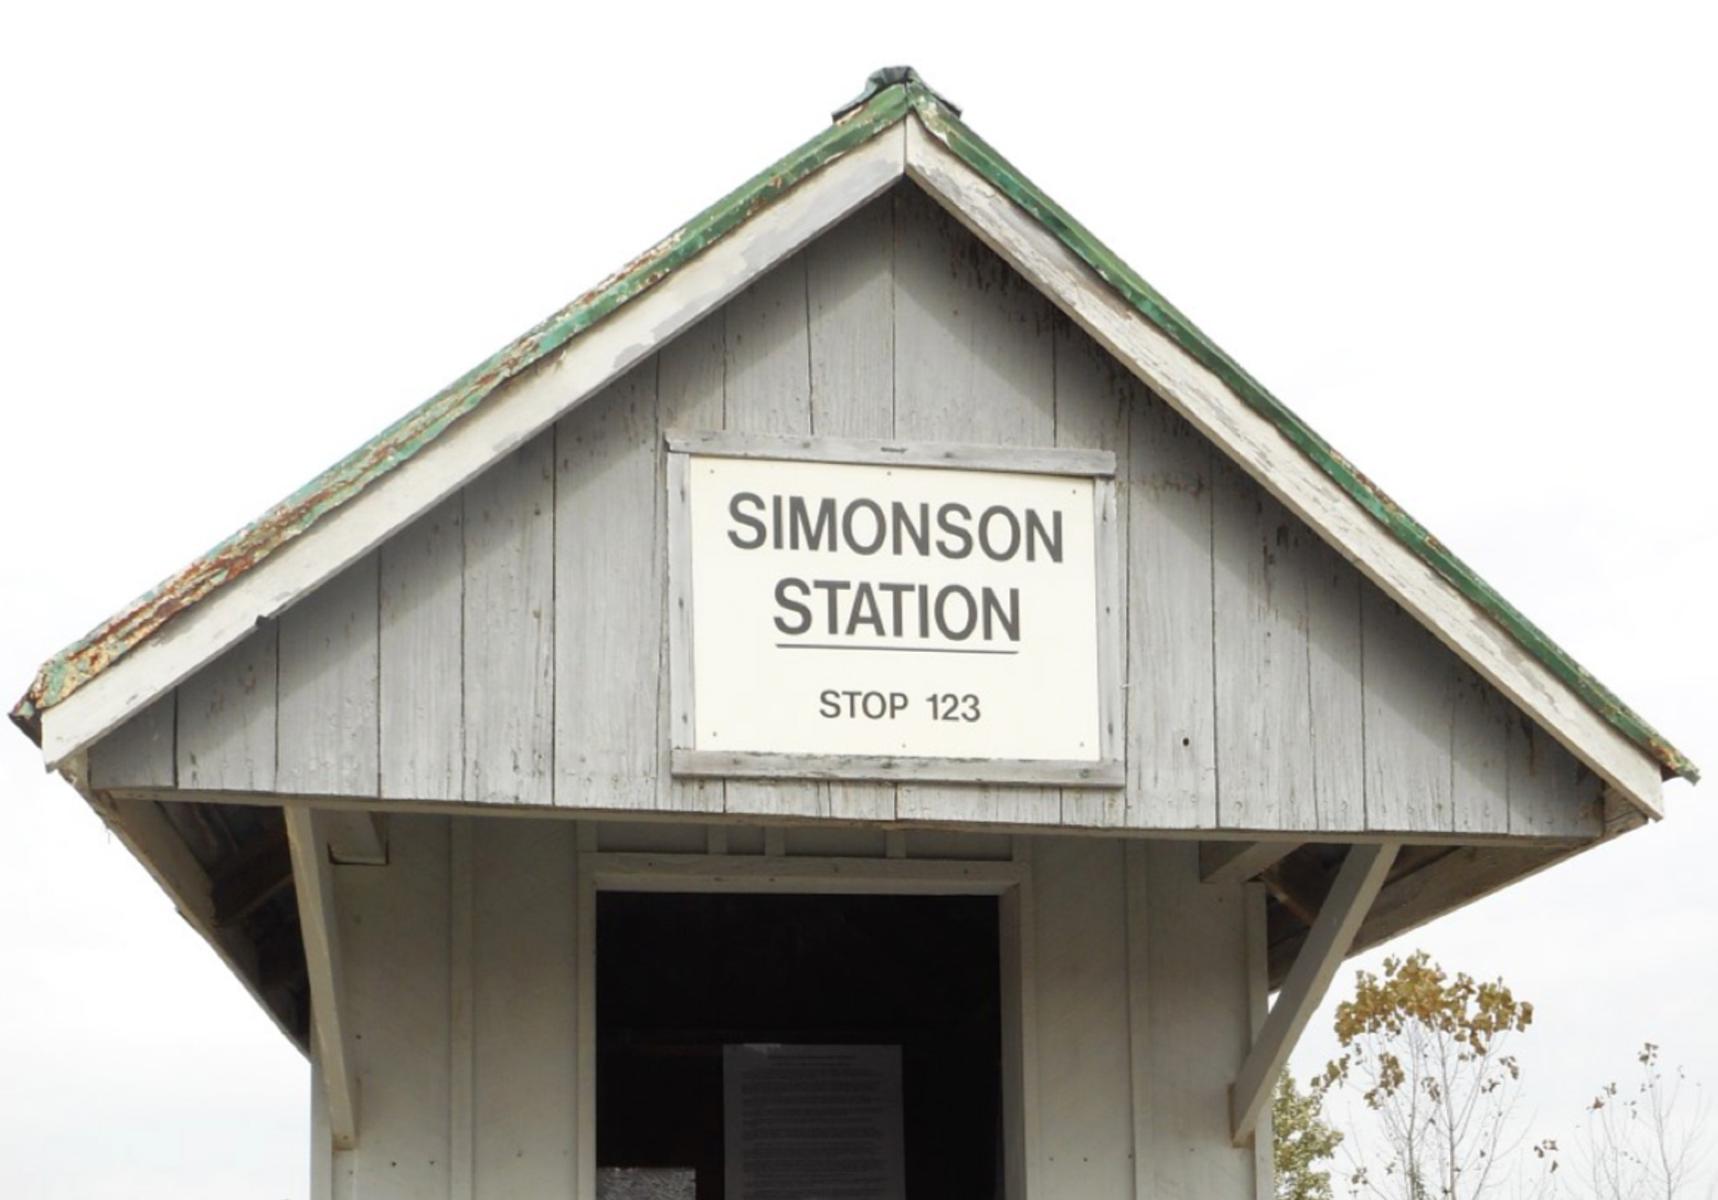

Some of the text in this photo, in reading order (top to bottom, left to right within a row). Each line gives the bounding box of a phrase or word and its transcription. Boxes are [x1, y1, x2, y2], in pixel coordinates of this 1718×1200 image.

[727, 492, 1063, 563] SIMONSON
[773, 577, 1020, 641] STATION
[819, 689, 981, 722] STOP 123
